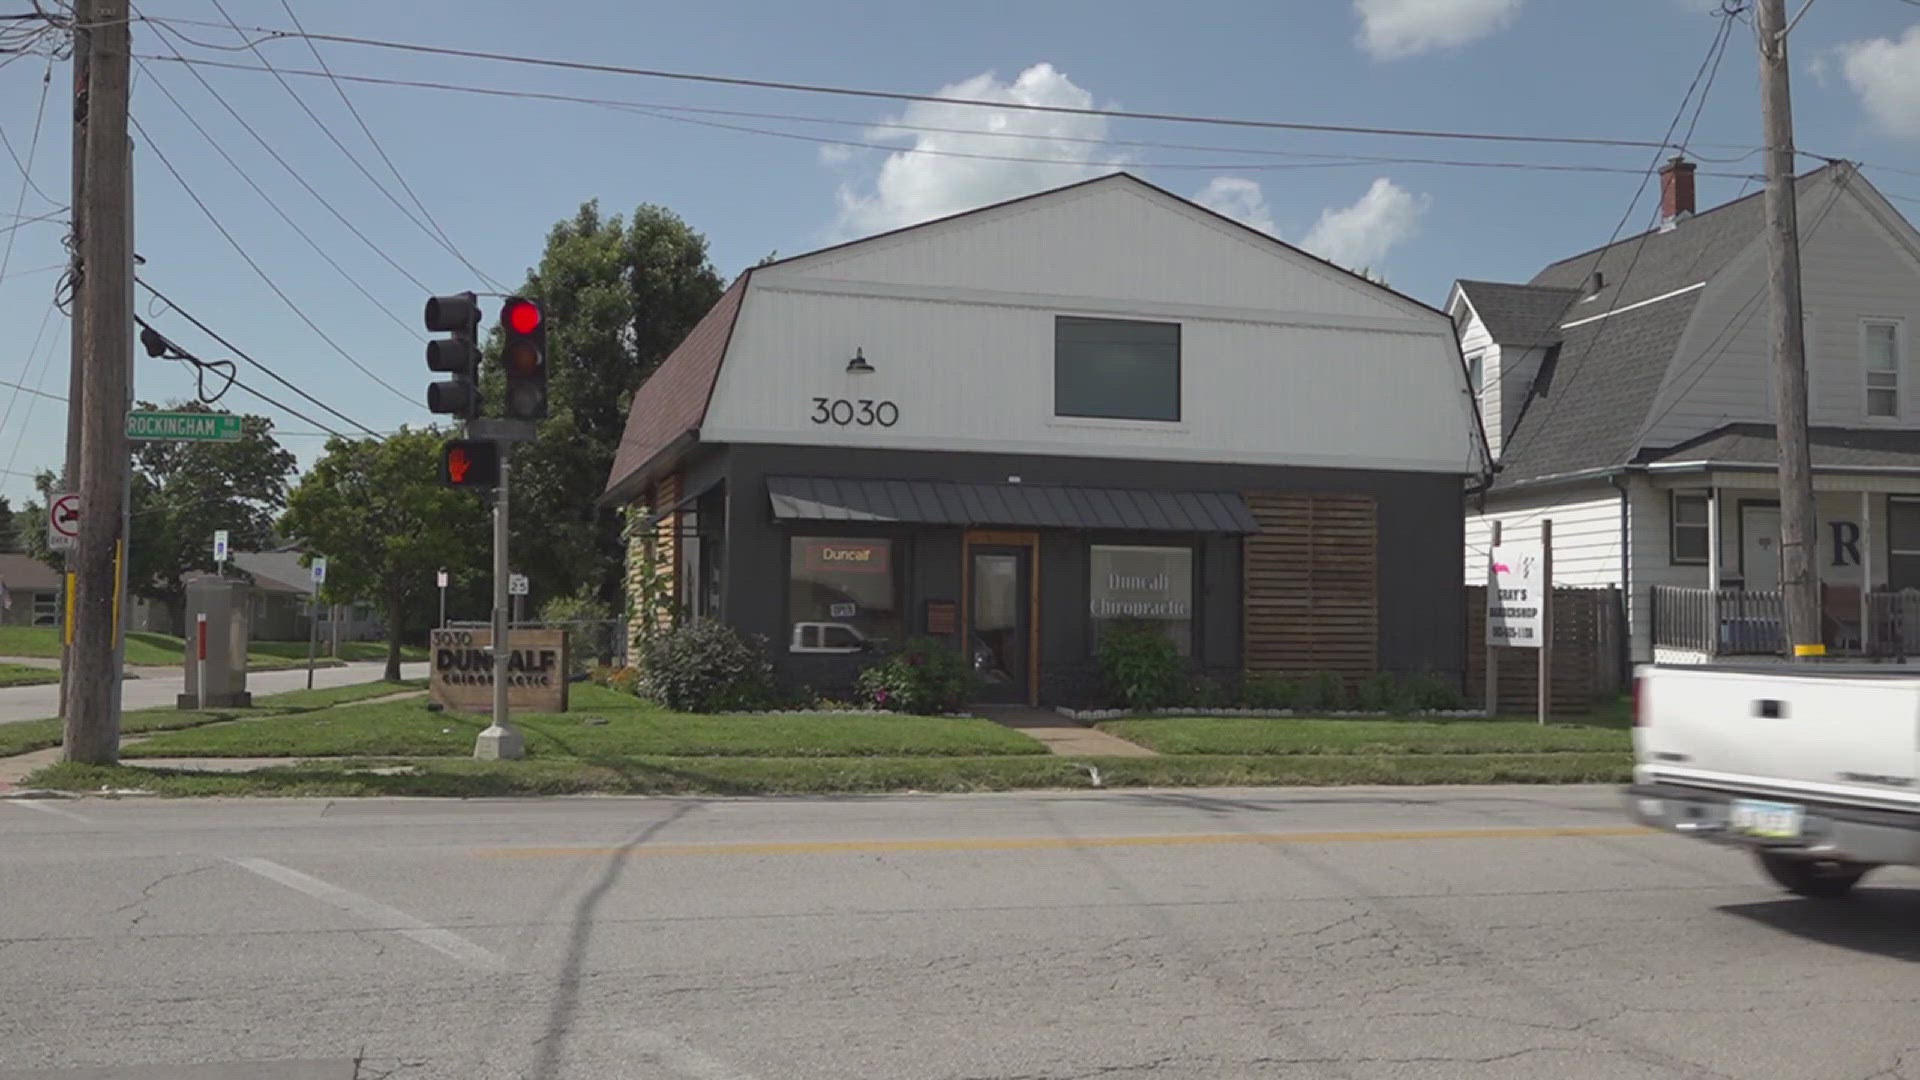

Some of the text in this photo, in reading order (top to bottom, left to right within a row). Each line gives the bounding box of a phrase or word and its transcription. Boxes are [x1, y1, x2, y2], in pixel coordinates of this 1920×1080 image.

[811, 397, 899, 427] 3030
[128, 417, 215, 436] ROCKINGHAM
[1827, 520, 1861, 567] R
[511, 581, 527, 592] 25
[432, 631, 472, 646] 3030
[436, 649, 555, 672] DUNALF
[442, 674, 549, 687] CHIROPACTIC
